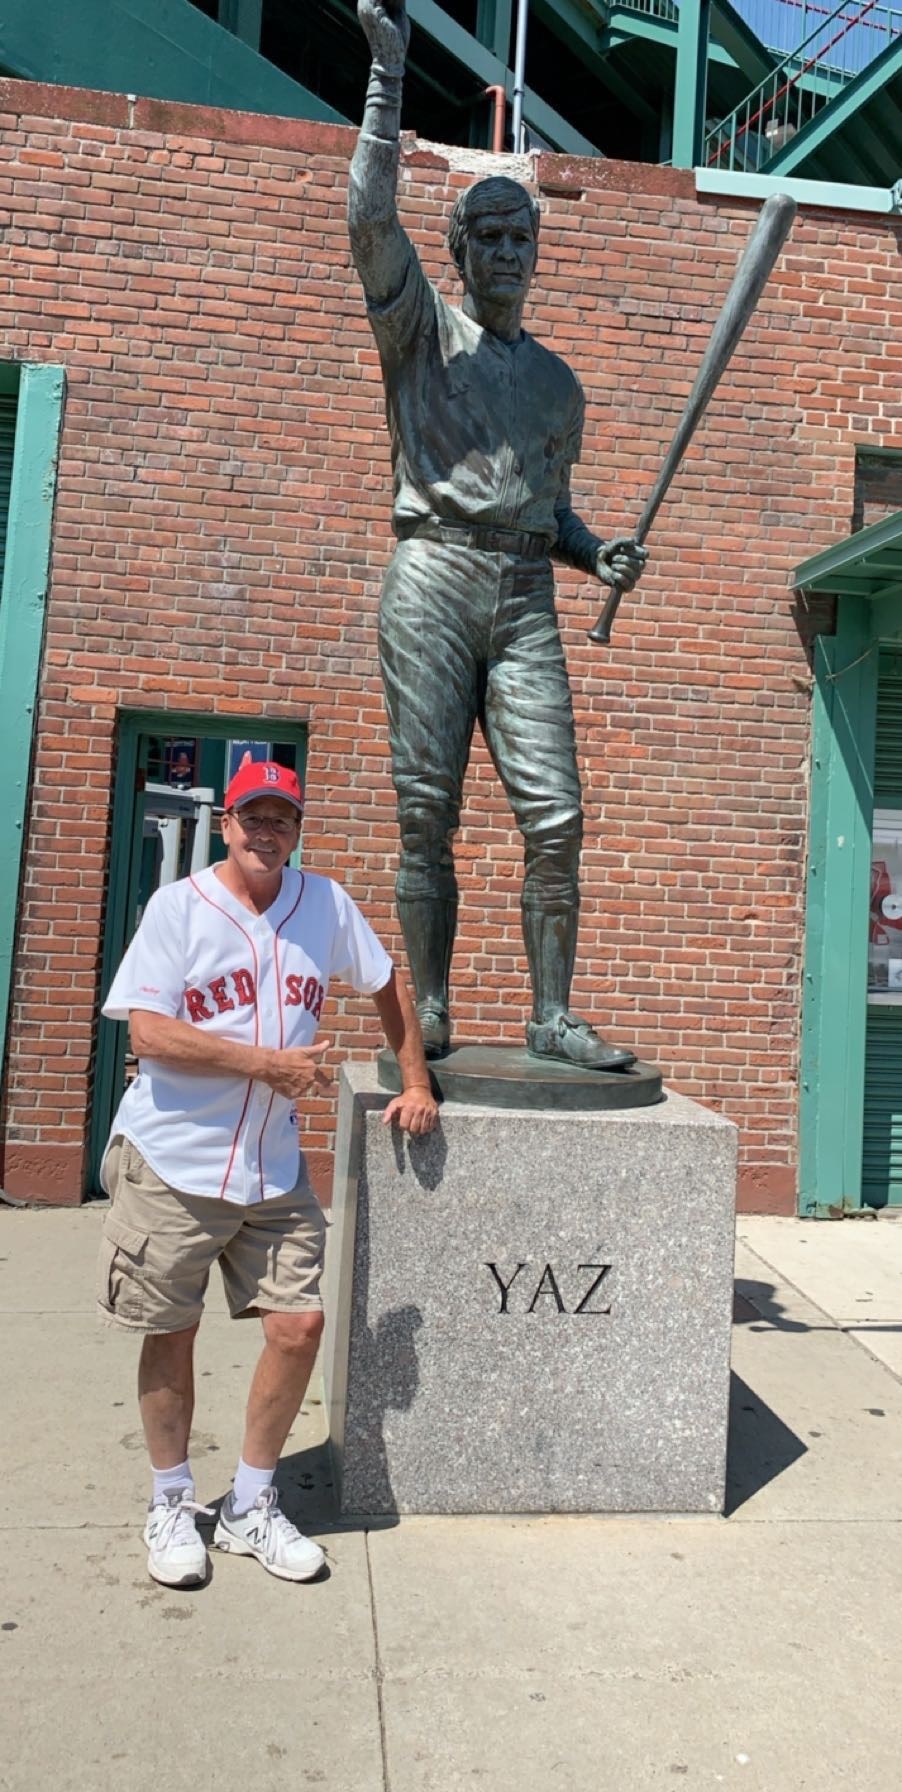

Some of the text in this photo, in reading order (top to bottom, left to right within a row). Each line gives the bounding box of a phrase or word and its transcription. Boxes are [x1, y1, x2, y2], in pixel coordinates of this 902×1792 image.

[262, 766, 280, 785] B
[184, 967, 256, 1023] RED
[484, 1263, 613, 1315] YAZ
